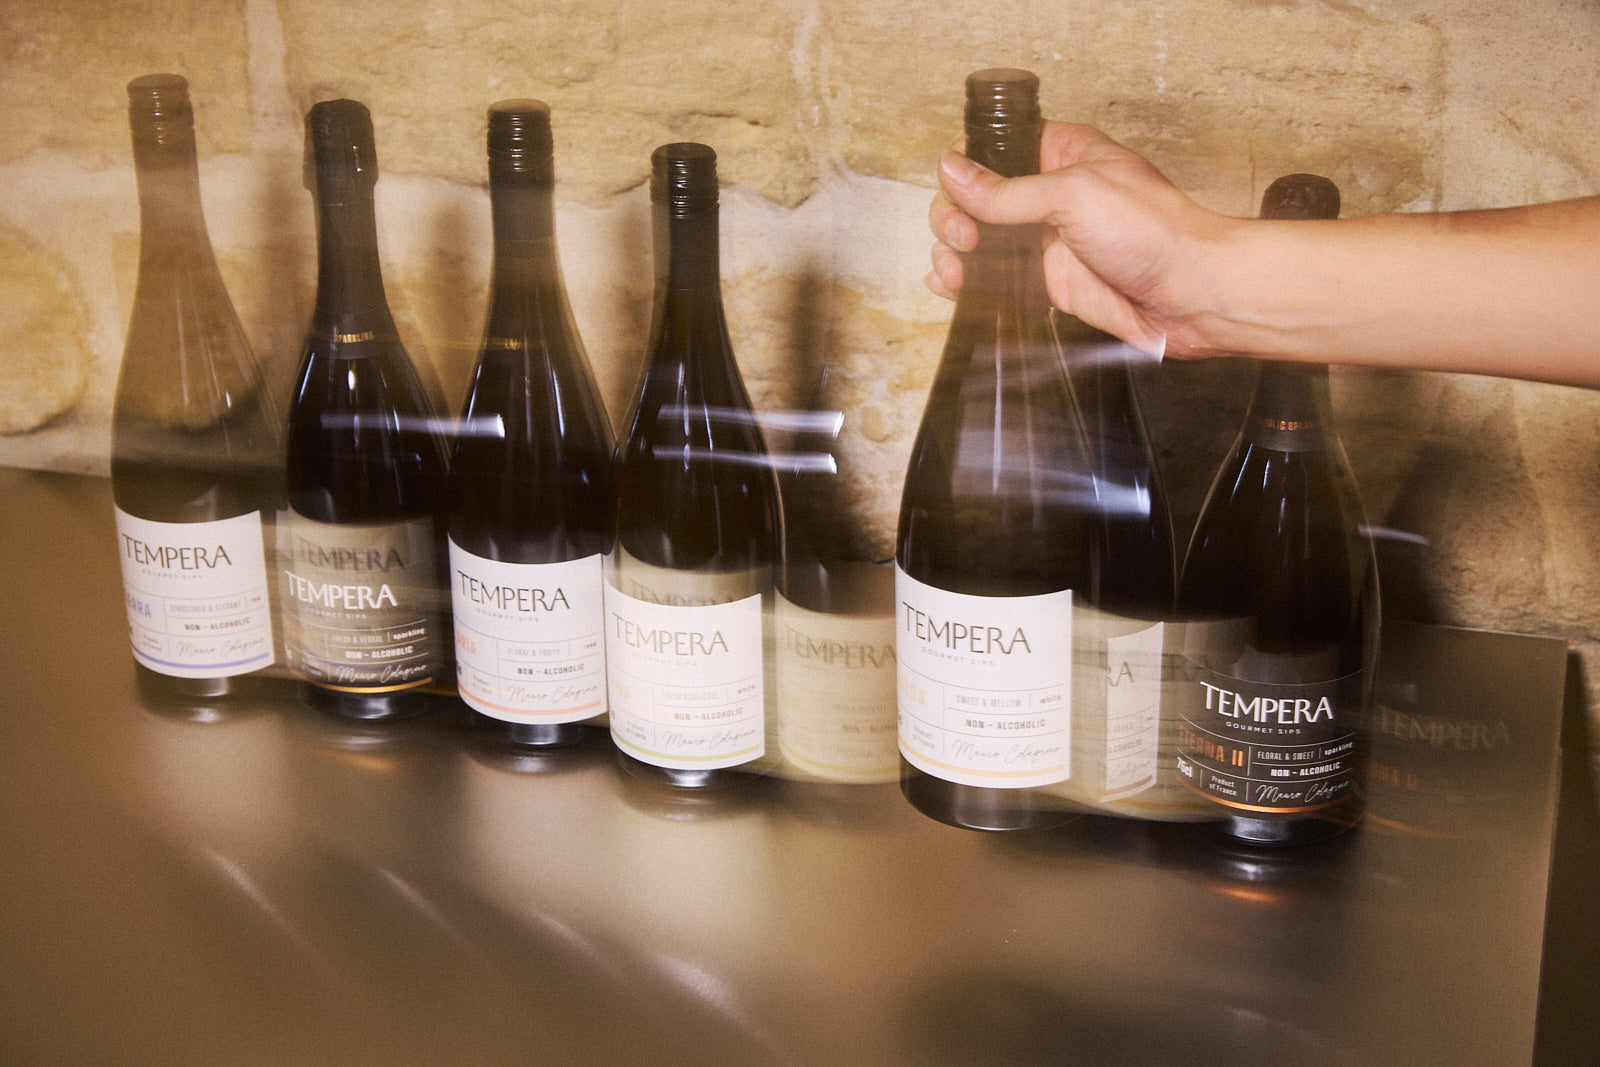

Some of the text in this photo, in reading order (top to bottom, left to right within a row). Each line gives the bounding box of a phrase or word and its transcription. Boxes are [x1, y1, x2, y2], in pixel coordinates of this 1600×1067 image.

[122, 533, 232, 570] TEMPERA
[284, 569, 398, 610] TEMPERA
[457, 569, 570, 612] TEMPERA
[393, 627, 425, 641] sparkling
[612, 612, 729, 656] TEMPERA
[903, 601, 1032, 655] TEMPERA
[344, 650, 362, 659] NON
[371, 646, 414, 659] ALCOHOLIC
[517, 667, 534, 676] NON
[543, 663, 585, 676] ALCOHOLIC
[1200, 681, 1334, 724] TEMPERA
[673, 712, 691, 721] NON
[701, 707, 744, 720] ALCOHOLIC
[965, 719, 985, 729] NON
[997, 718, 1046, 730] ALCOHOLIC
[1225, 721, 1273, 734] GOURMET
[1257, 750, 1282, 761] FLORAL
[1292, 750, 1314, 760] SWEET
[1324, 741, 1353, 756] sparkling
[1177, 756, 1193, 778] 75cl
[1270, 768, 1290, 777] NON
[1299, 761, 1340, 777] ALCOHOLIC
[1211, 775, 1235, 788] Product
[1216, 785, 1237, 796] France
